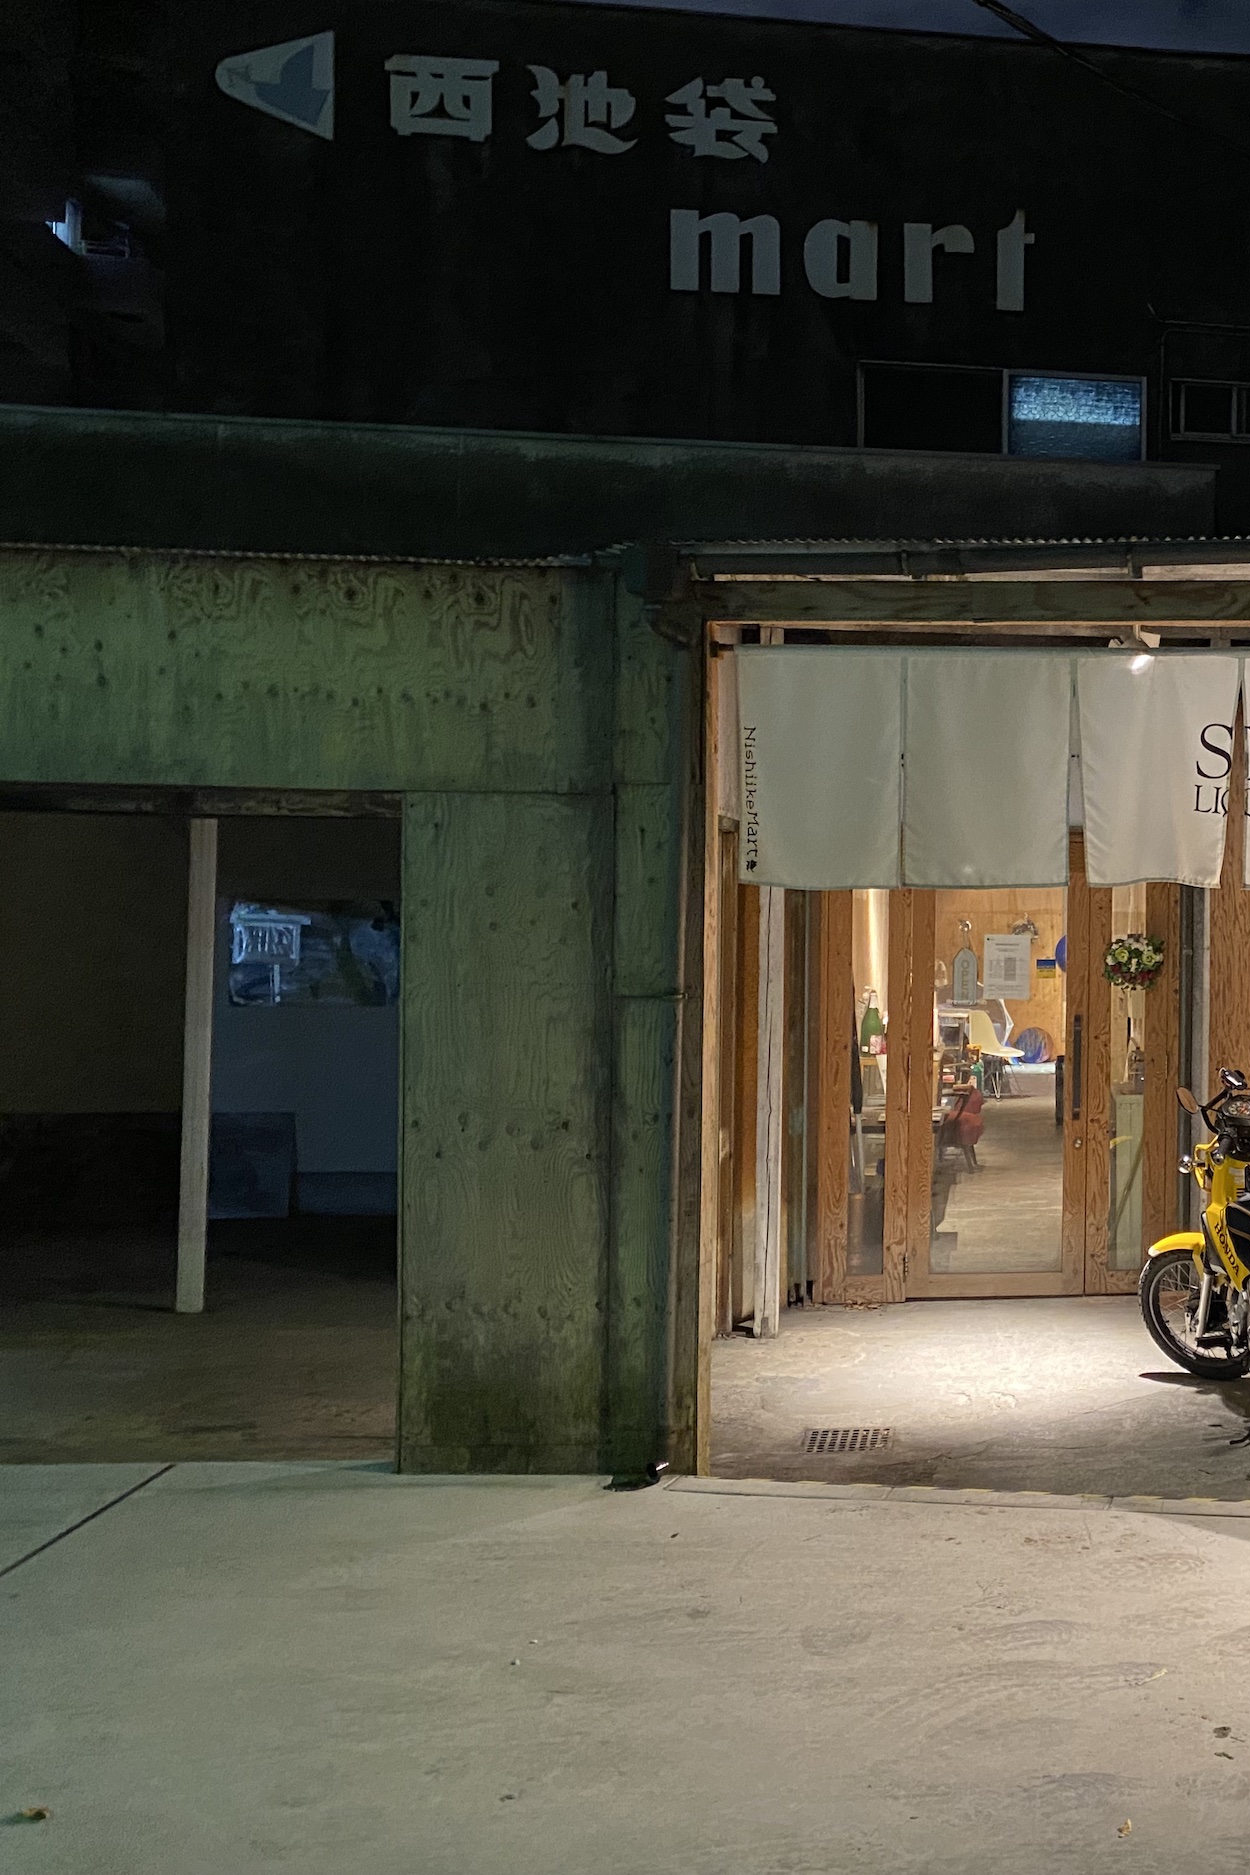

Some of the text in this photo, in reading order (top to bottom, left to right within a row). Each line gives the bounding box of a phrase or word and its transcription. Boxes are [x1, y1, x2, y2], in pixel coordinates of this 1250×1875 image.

[384, 54, 779, 164] 西池袋
[669, 208, 1036, 312] mart
[743, 726, 760, 859] NishiikeMart
[1214, 1221, 1240, 1278] HONDA
